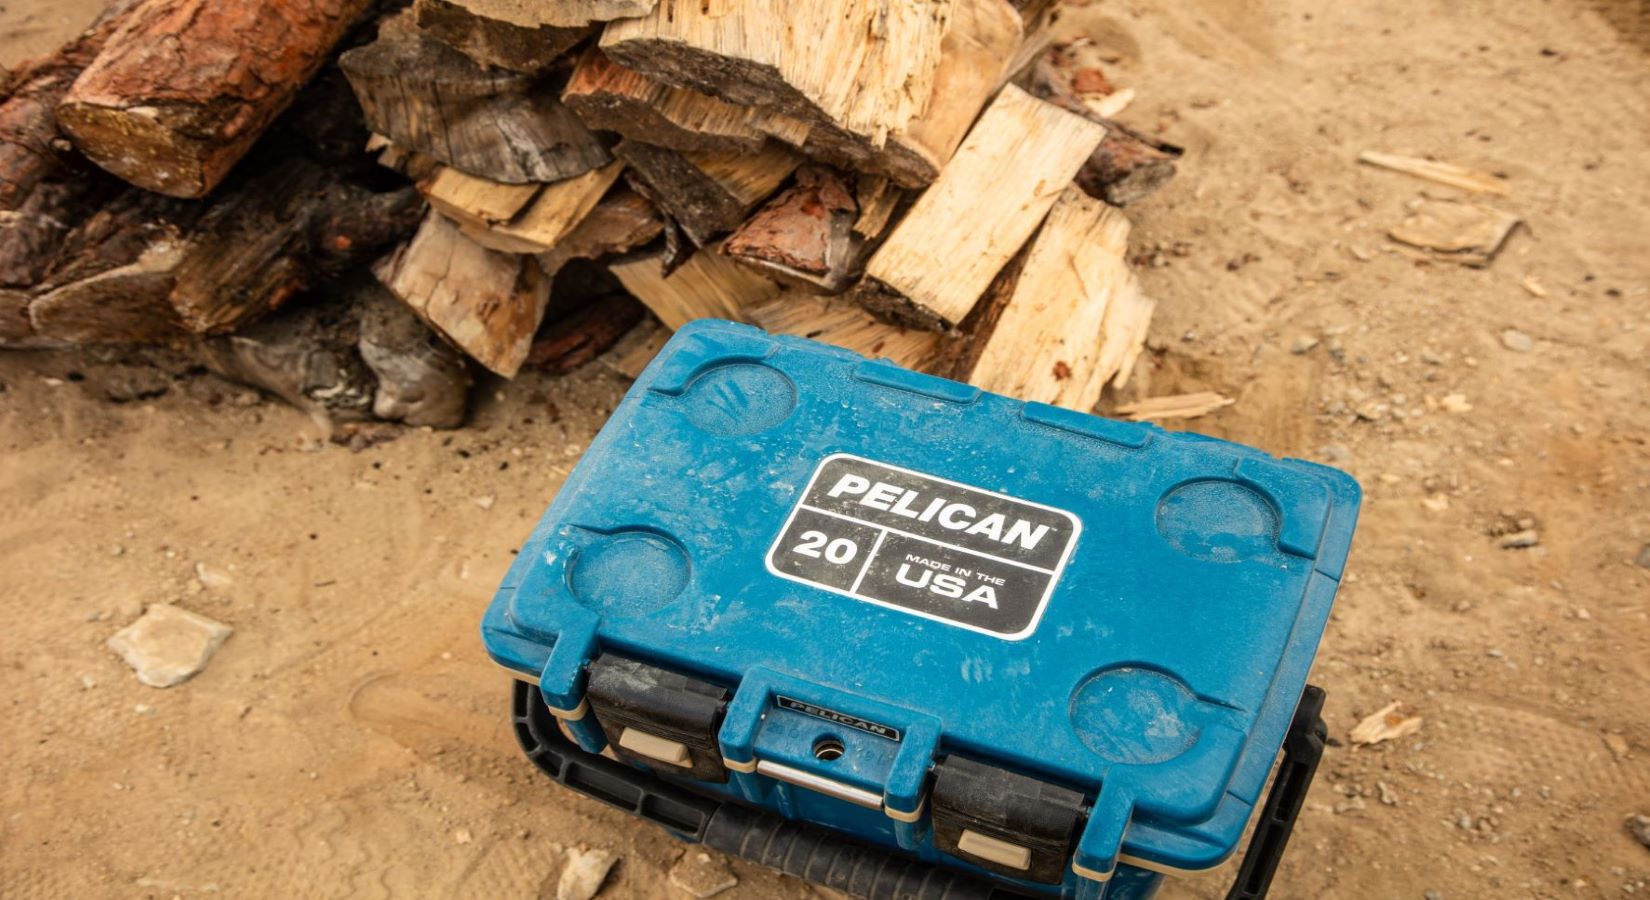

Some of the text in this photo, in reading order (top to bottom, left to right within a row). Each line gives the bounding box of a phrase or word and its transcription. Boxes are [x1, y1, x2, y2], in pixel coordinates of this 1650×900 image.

[827, 473, 1050, 550] PELICAN
[792, 530, 858, 564] 20
[895, 562, 999, 610] USA
[905, 553, 1006, 586] MADE IN THE
[790, 701, 886, 734] PELICAN
